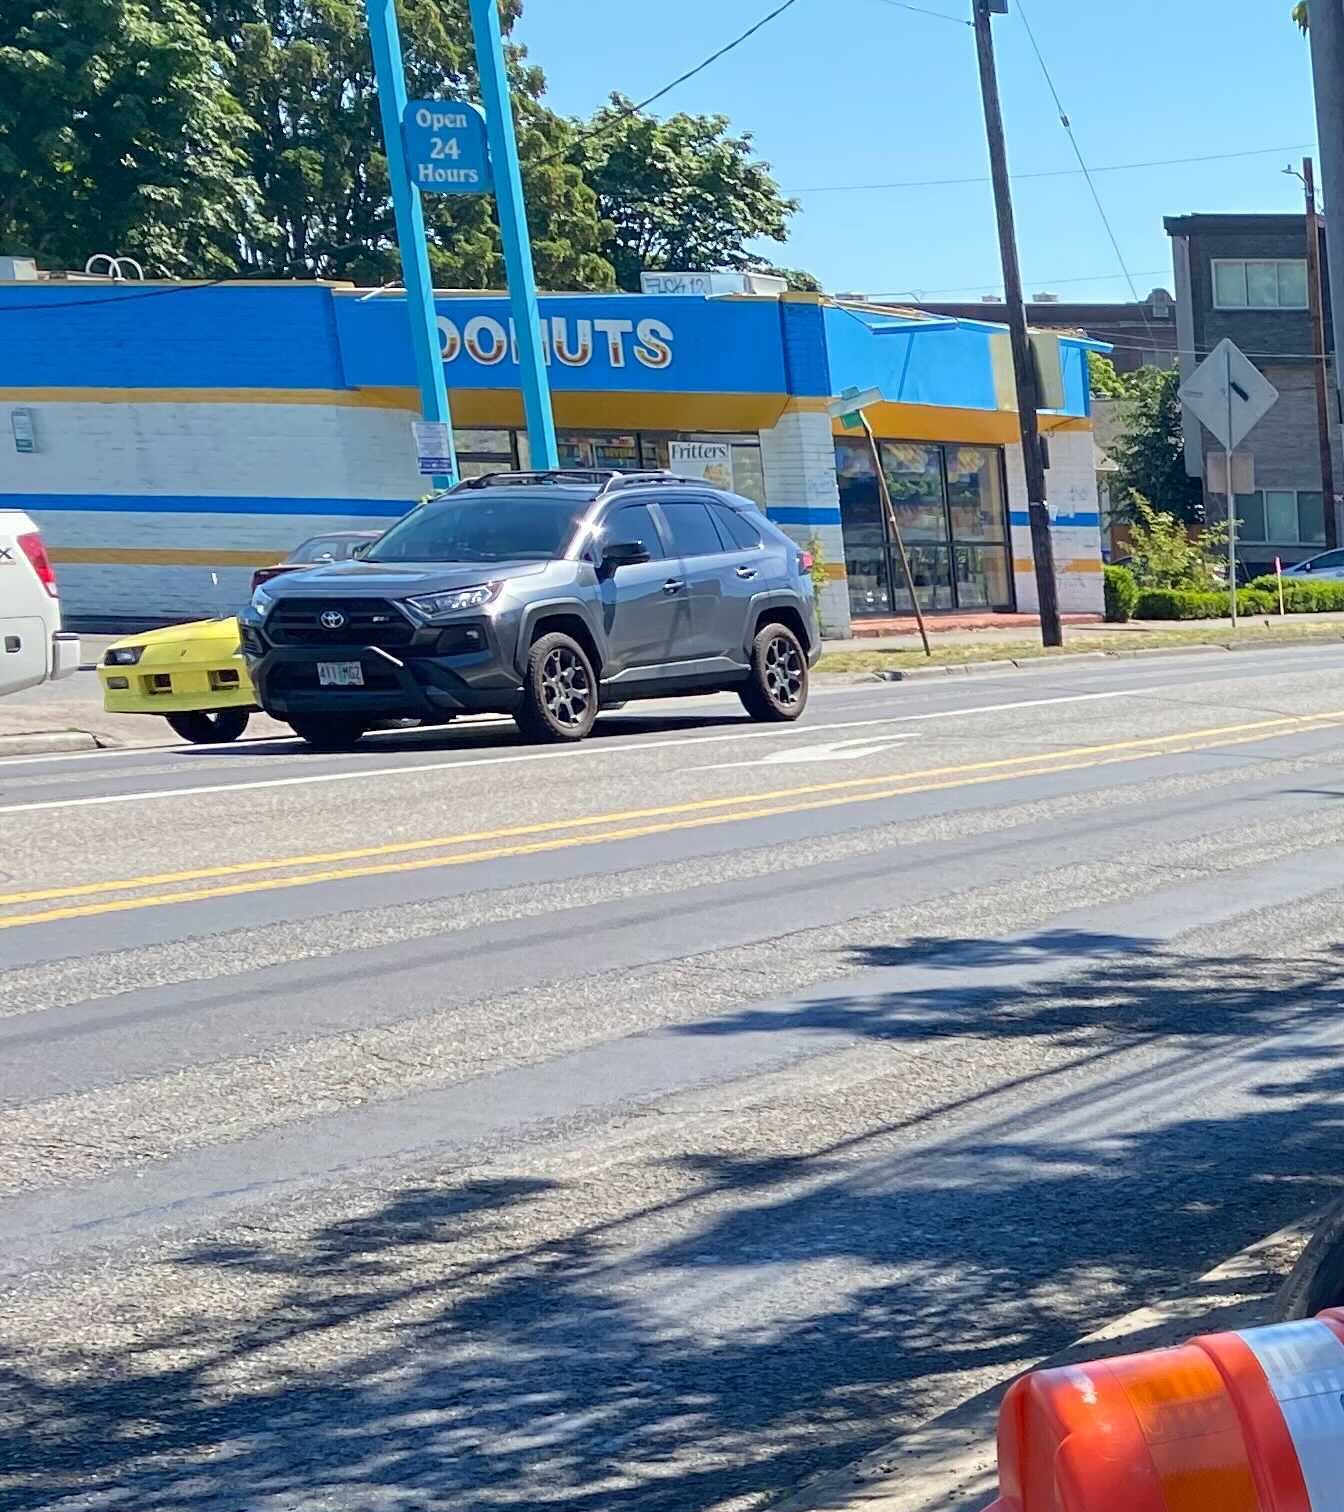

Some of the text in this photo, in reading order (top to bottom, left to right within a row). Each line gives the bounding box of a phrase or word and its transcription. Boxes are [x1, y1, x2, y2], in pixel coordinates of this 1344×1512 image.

[416, 108, 468, 131] Open
[430, 137, 461, 159] 24
[418, 163, 479, 182] Hours
